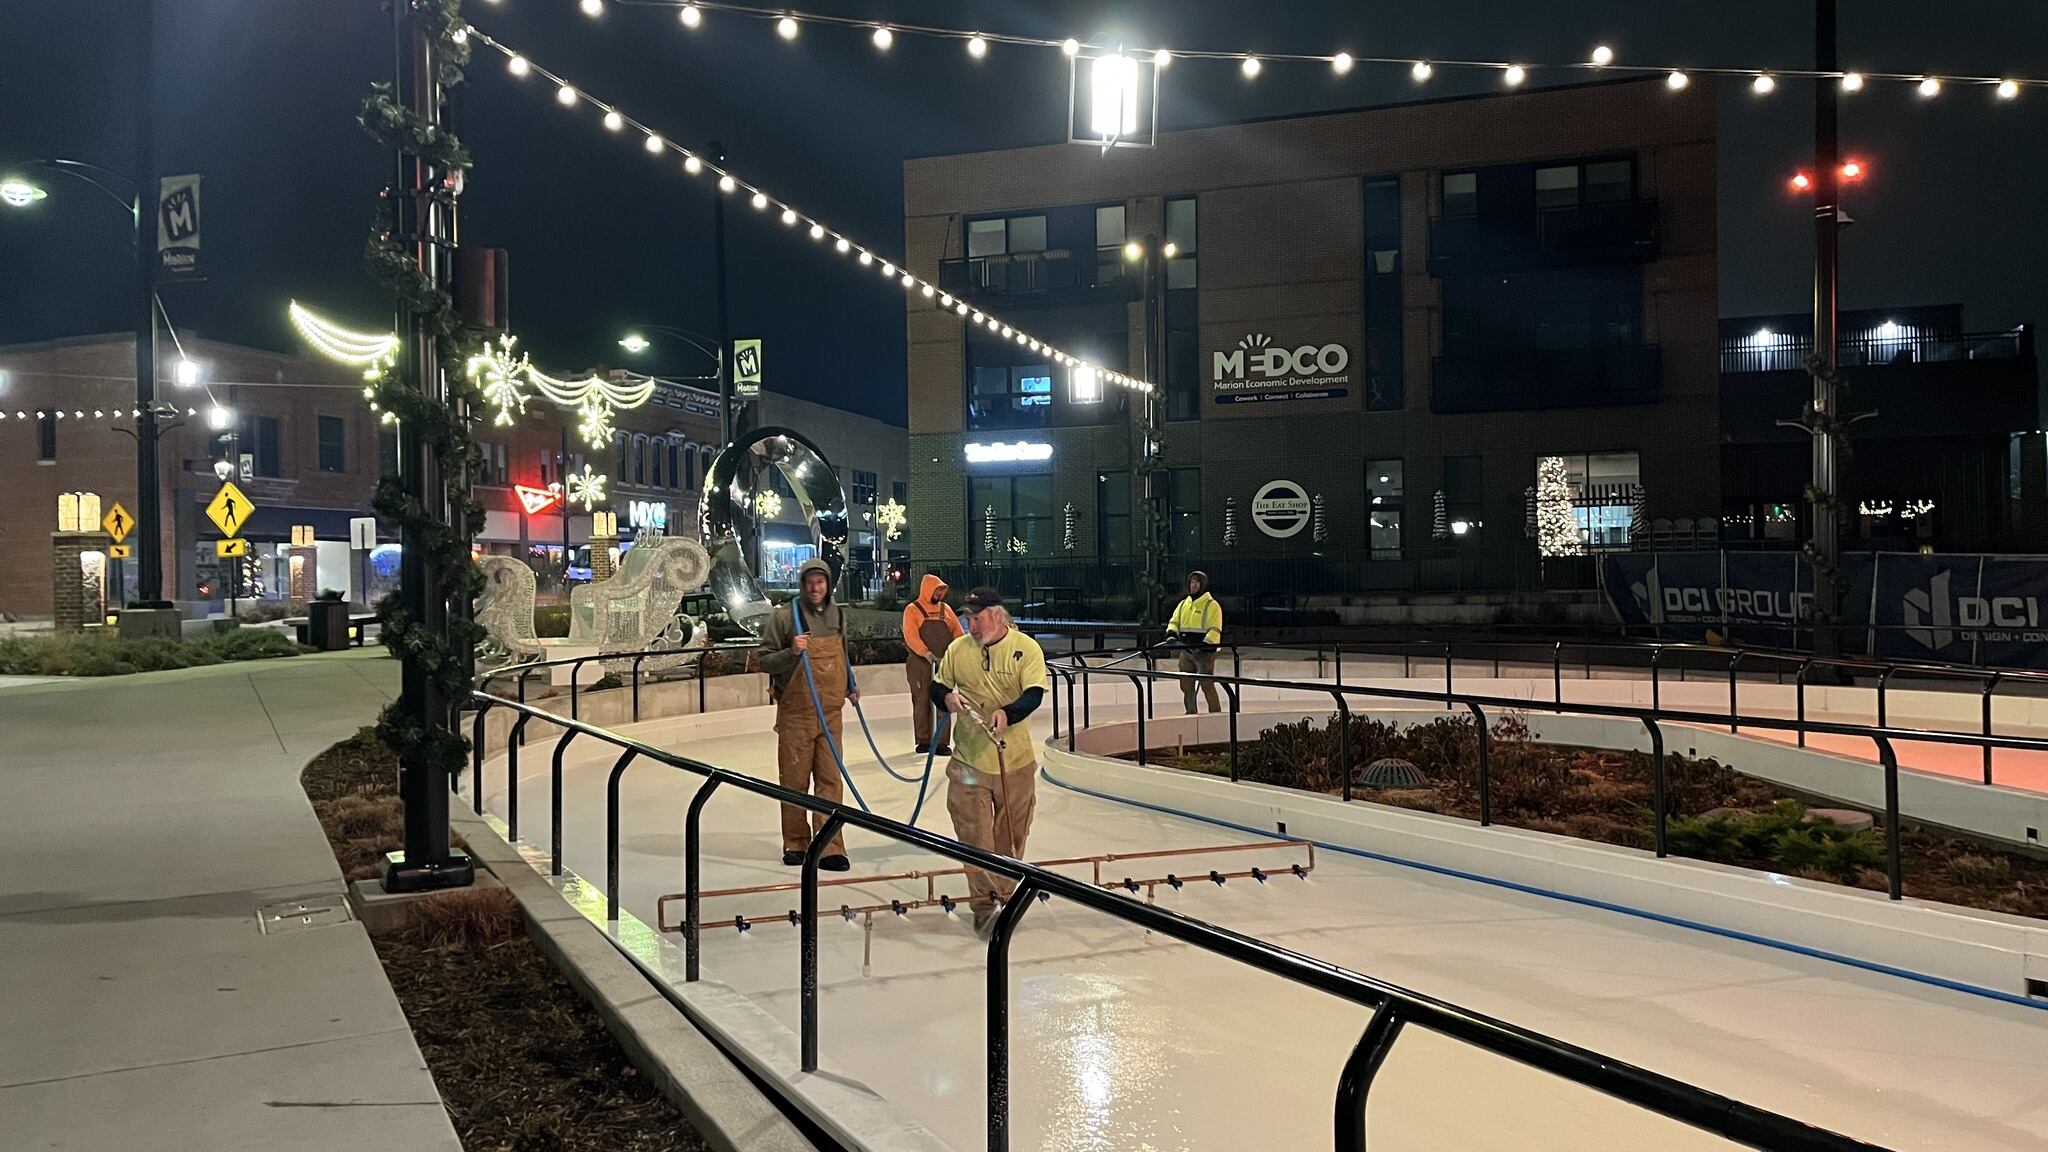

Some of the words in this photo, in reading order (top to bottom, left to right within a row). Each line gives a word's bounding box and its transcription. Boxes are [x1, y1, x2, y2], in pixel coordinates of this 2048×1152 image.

[1213, 343, 1349, 381] MEDCO
[1214, 381, 1244, 390] Marion
[1246, 379, 1288, 388] Economic
[1289, 375, 1349, 386] Development
[1264, 393, 1289, 401] Connect
[1295, 390, 1329, 398] Collaborate
[1663, 587, 1711, 612] DCI
[1958, 597, 2038, 627] DCI
